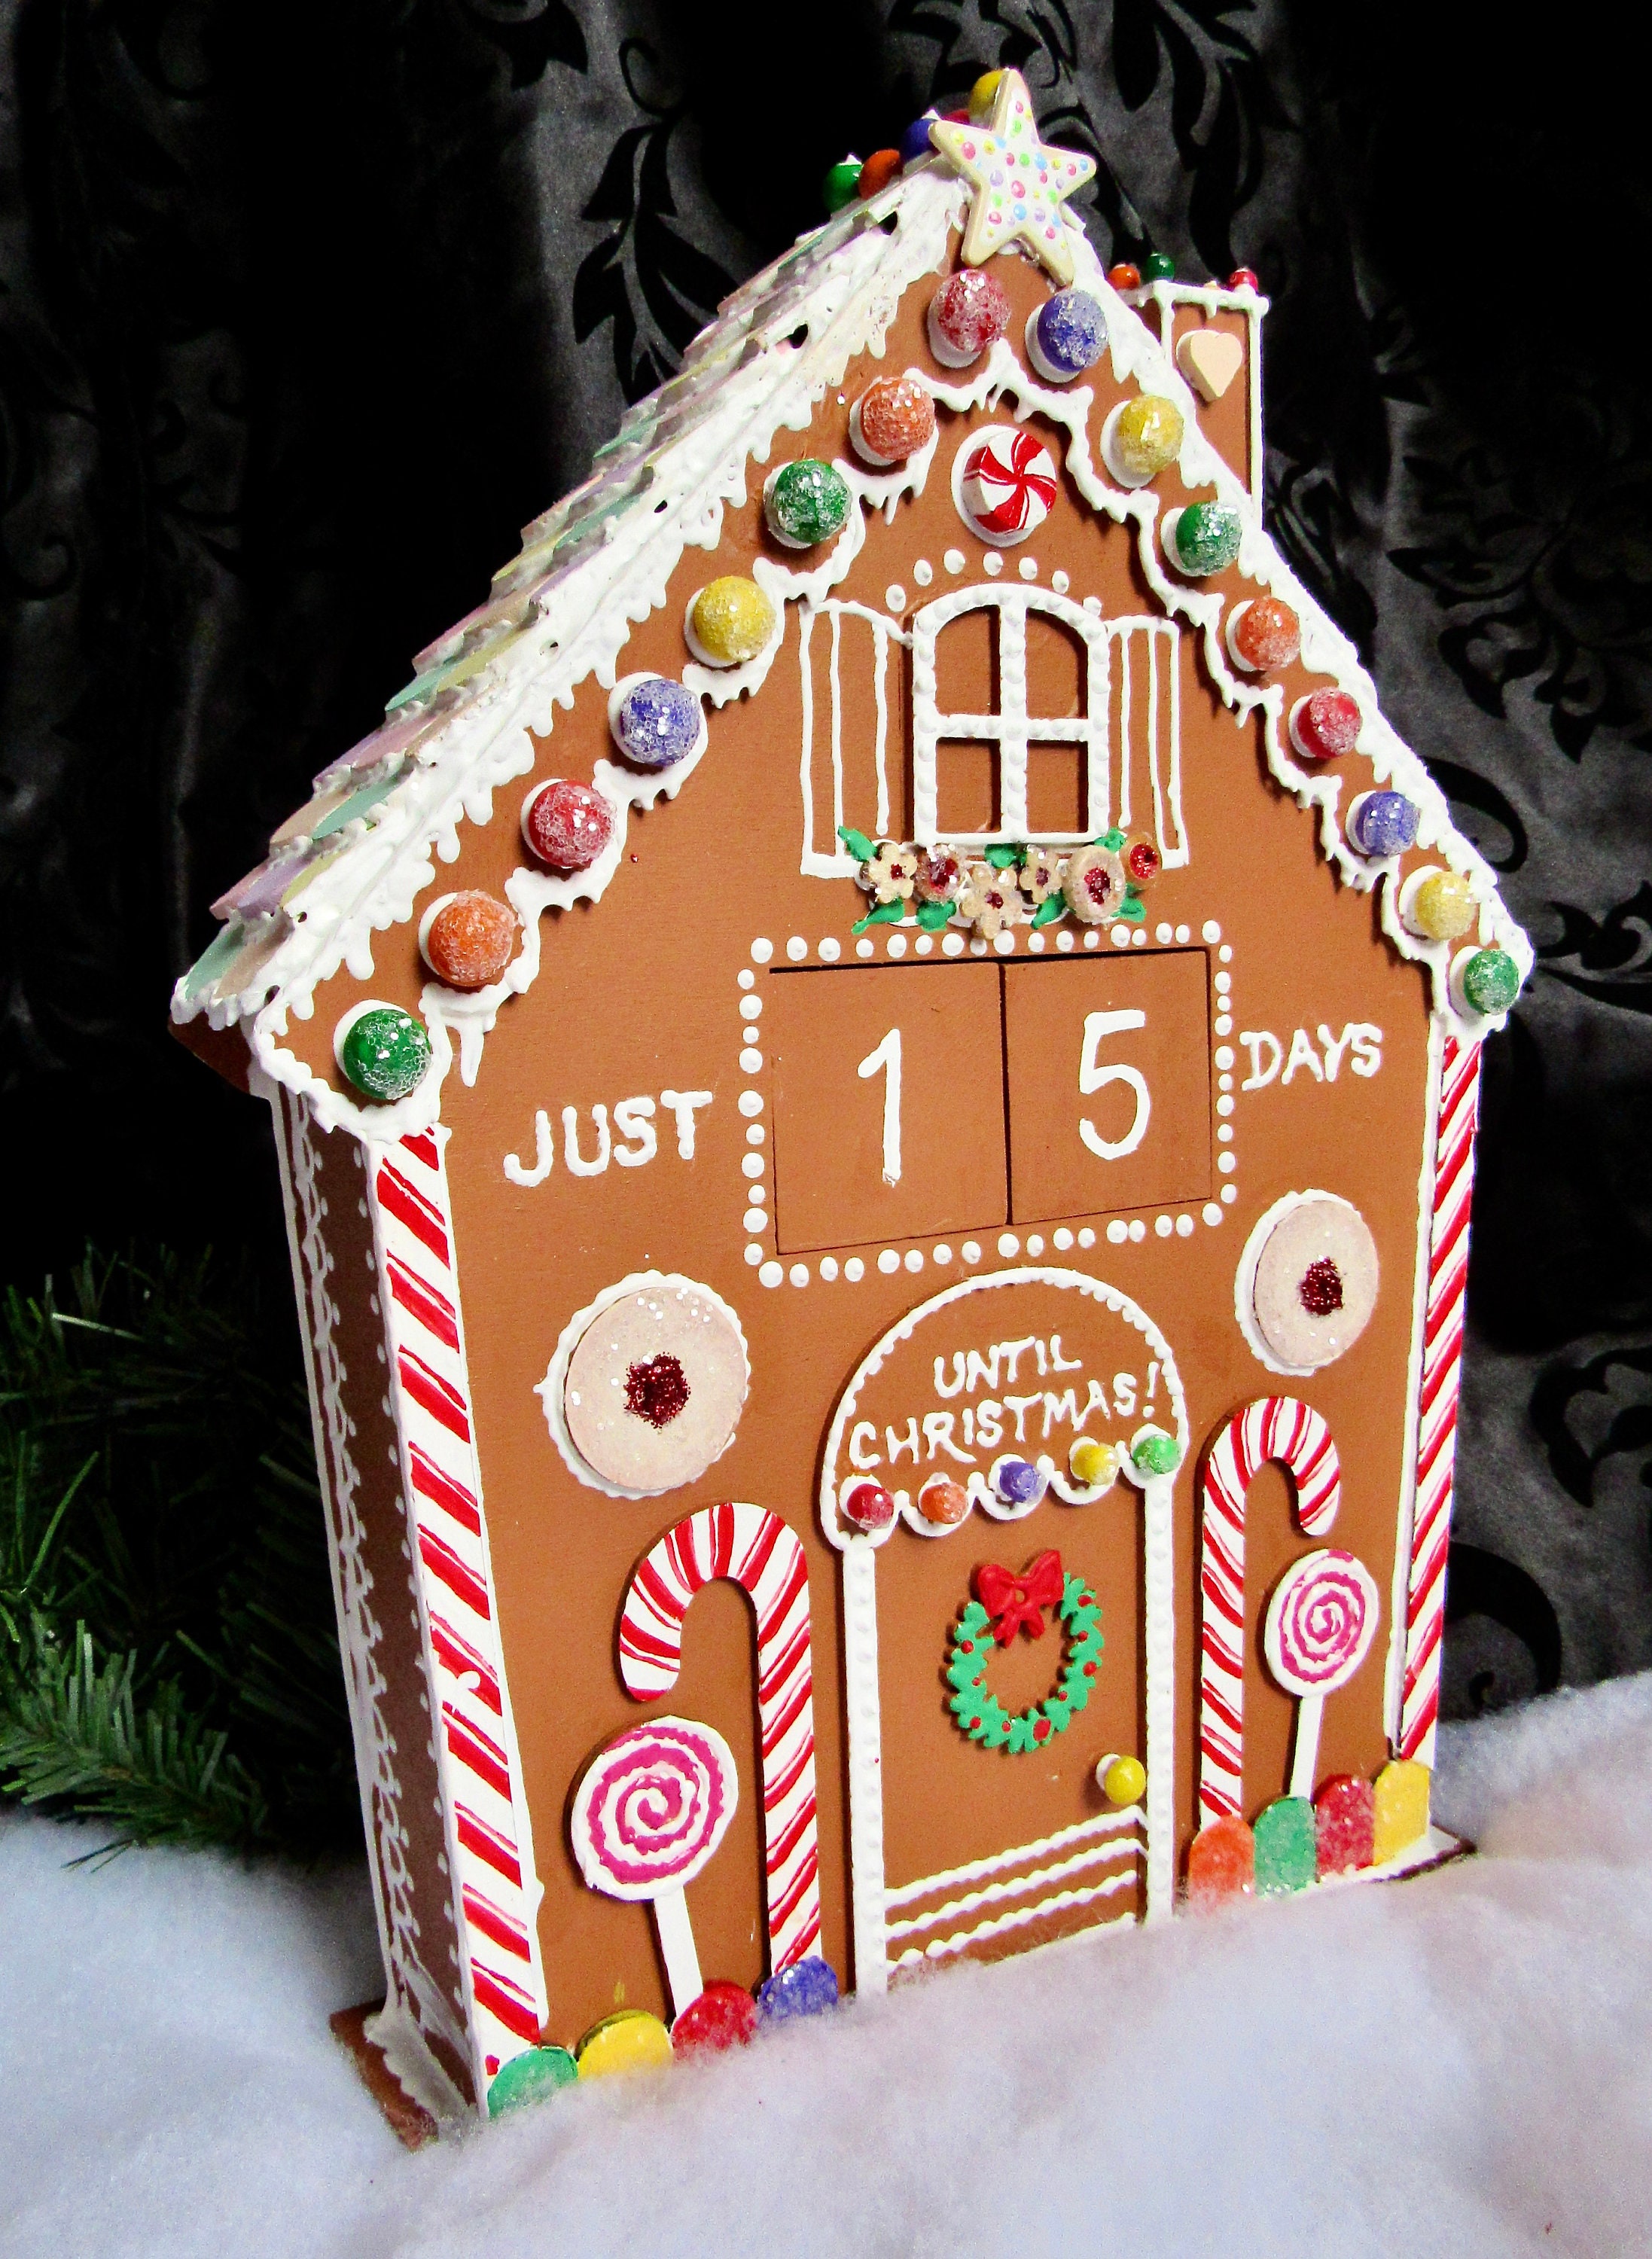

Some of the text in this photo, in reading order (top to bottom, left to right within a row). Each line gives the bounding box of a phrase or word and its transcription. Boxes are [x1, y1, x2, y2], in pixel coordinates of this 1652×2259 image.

[503, 1090, 715, 1187] JUST
[1239, 1022, 1385, 1092] DAYS
[849, 1361, 1160, 1470] CHRISTMAS!
[934, 1334, 1083, 1398] UNTIL
